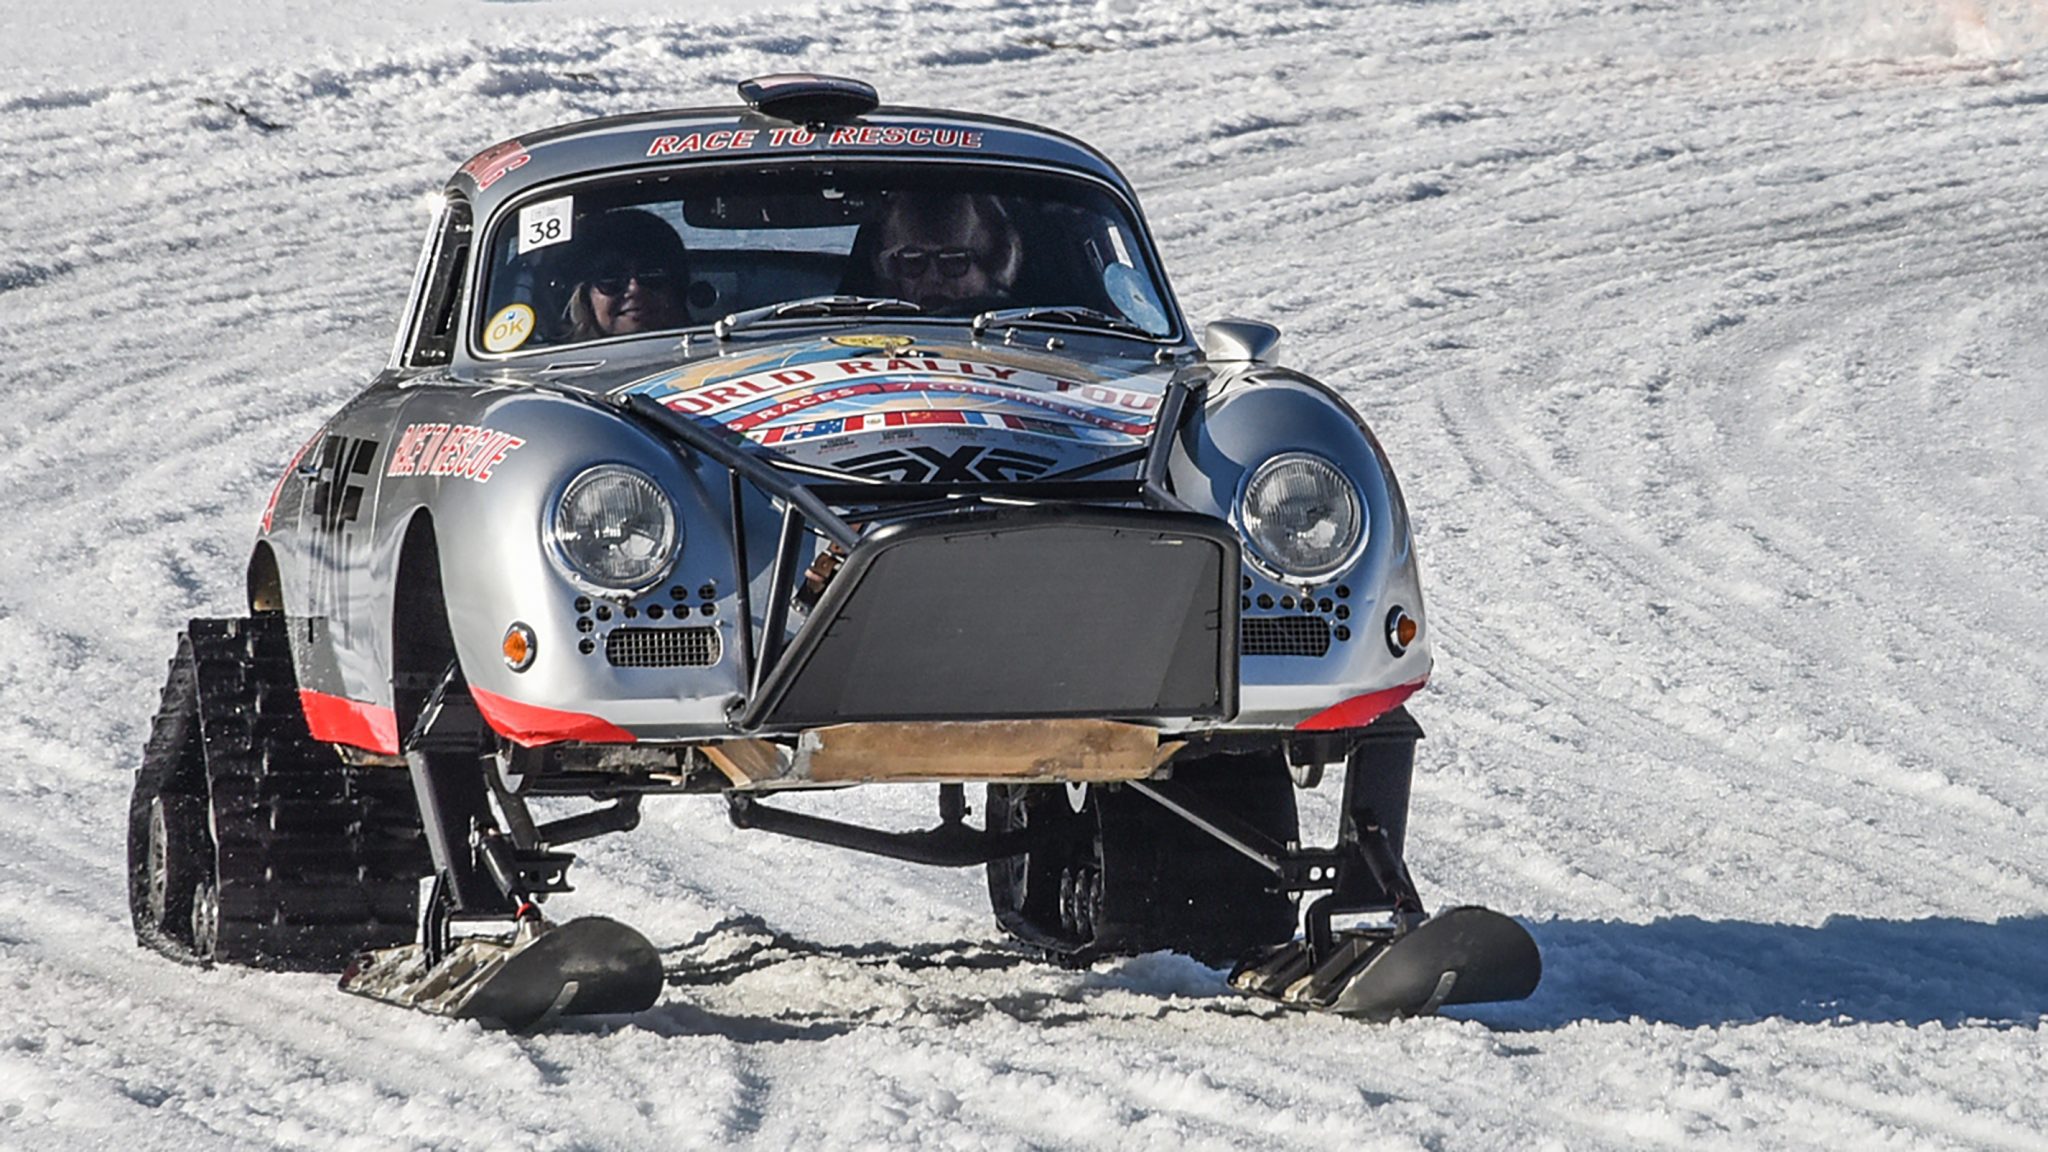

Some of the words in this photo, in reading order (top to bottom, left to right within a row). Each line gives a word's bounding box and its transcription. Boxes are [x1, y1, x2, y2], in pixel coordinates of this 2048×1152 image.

[647, 129, 760, 157] RACE
[768, 127, 817, 147] TO
[829, 126, 985, 148] RESCUE
[529, 218, 561, 245] 38
[493, 318, 525, 341] OK
[665, 369, 817, 415] ORLD
[837, 359, 1018, 380] RALLY
[1046, 376, 1160, 410] TOU
[757, 388, 856, 421] RACES
[928, 382, 1126, 432] CONTINENTS
